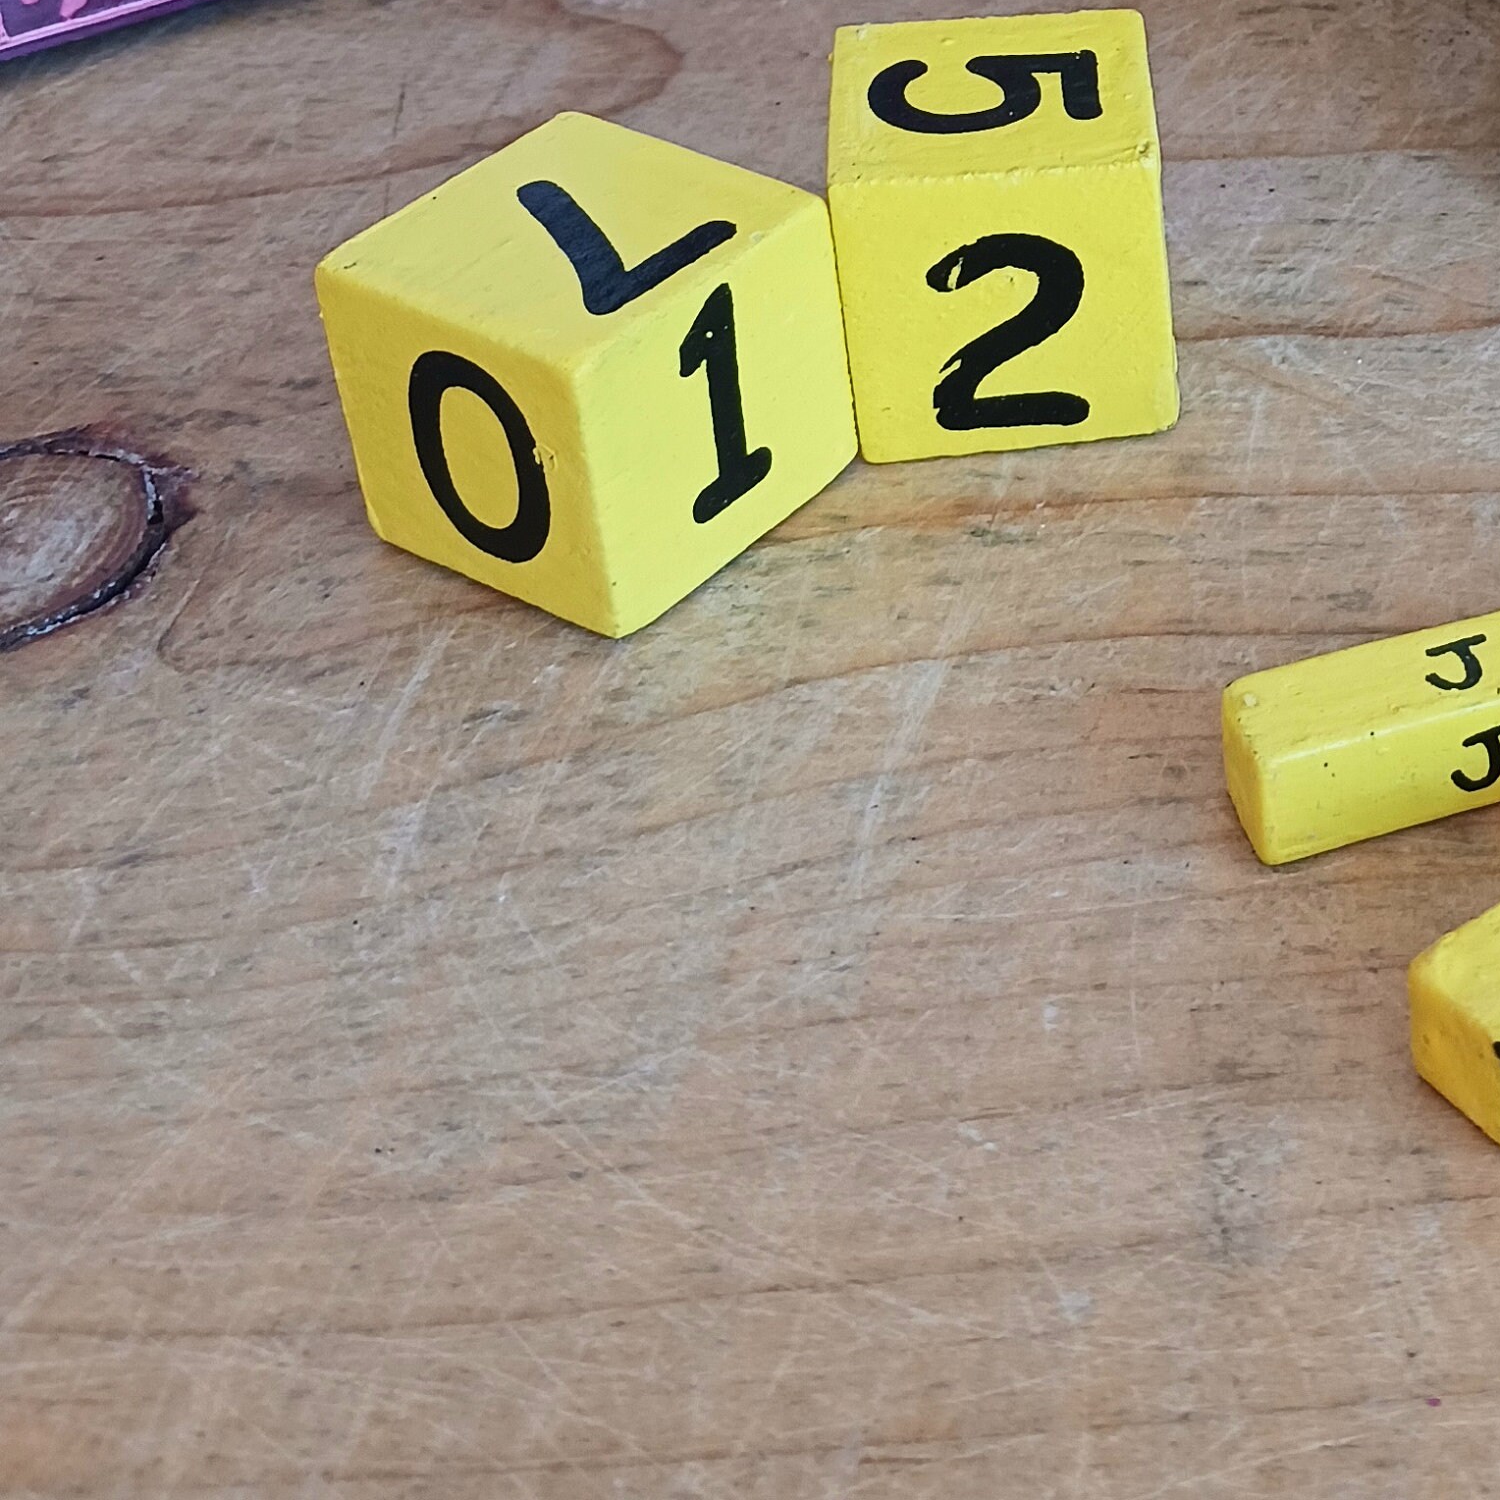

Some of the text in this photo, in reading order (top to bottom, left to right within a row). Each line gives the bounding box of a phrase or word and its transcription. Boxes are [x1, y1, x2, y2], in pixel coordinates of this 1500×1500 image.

[867, 49, 1102, 135] 5
[678, 282, 772, 524] 1
[925, 233, 1091, 431] 2
